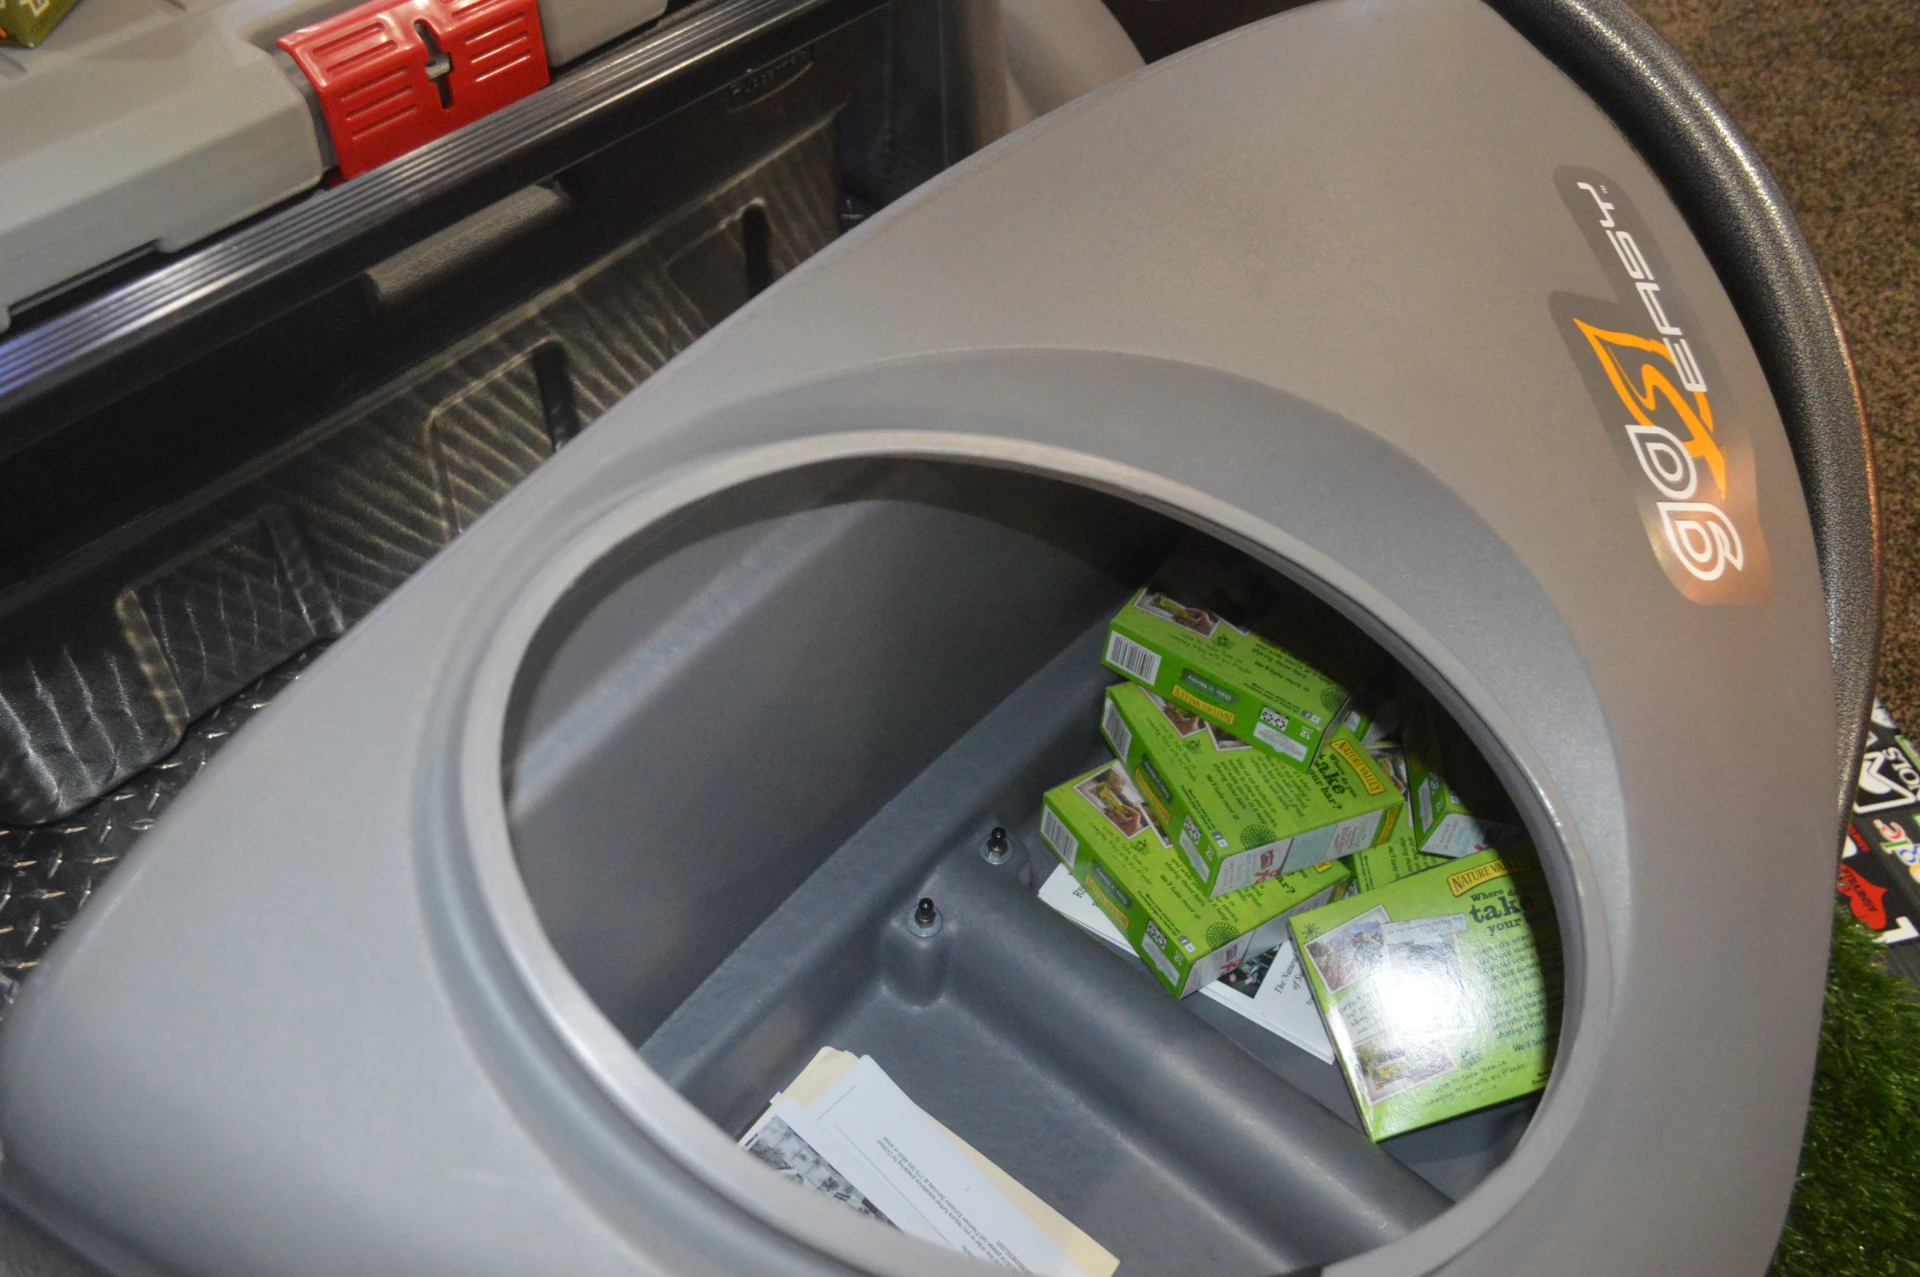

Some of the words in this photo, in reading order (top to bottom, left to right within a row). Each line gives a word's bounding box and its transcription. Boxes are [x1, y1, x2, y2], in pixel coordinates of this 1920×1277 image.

[1625, 424, 1743, 581] go
[1173, 686, 1203, 708] VALLEY
[1203, 702, 1232, 723] NATURE
[1311, 749, 1348, 798] take
[1329, 754, 1345, 776] Where
[1338, 741, 1366, 771] NATURE
[1361, 767, 1384, 793] VALLEY
[1882, 746, 1920, 797] OLS
[1205, 773, 1217, 787] We'll
[1213, 785, 1225, 800] bake
[1222, 798, 1234, 814] more
[1307, 766, 1323, 788] our
[1320, 783, 1342, 812] bar?
[1452, 866, 1490, 893] NATURE
[1158, 873, 1173, 887] We'll
[1169, 885, 1183, 900] bake
[1180, 898, 1195, 913] more
[1469, 886, 1504, 902] Where
[1467, 888, 1535, 925] take
[1487, 917, 1522, 937] your
[1273, 978, 1287, 994] The
[1280, 953, 1300, 981] Natural
[1289, 980, 1302, 991] of
[875, 1137, 893, 1156] Outdoor
[881, 1135, 895, 1148] email
[890, 1153, 899, 1162] for
[896, 1158, 918, 1180] preparing
[927, 1181, 946, 1200] Services
[933, 1197, 950, 1213] further
[943, 1198, 963, 1218] Exhibitor
[947, 1210, 964, 1227] require
[960, 1215, 981, 1236] Freeman
[961, 1224, 972, 1235] you
[978, 1233, 988, 1243] call
[973, 1237, 988, 1252] order
[984, 1249, 995, 1260] this
[985, 1240, 1003, 1257] please
[999, 1254, 1013, 1269] 2014
